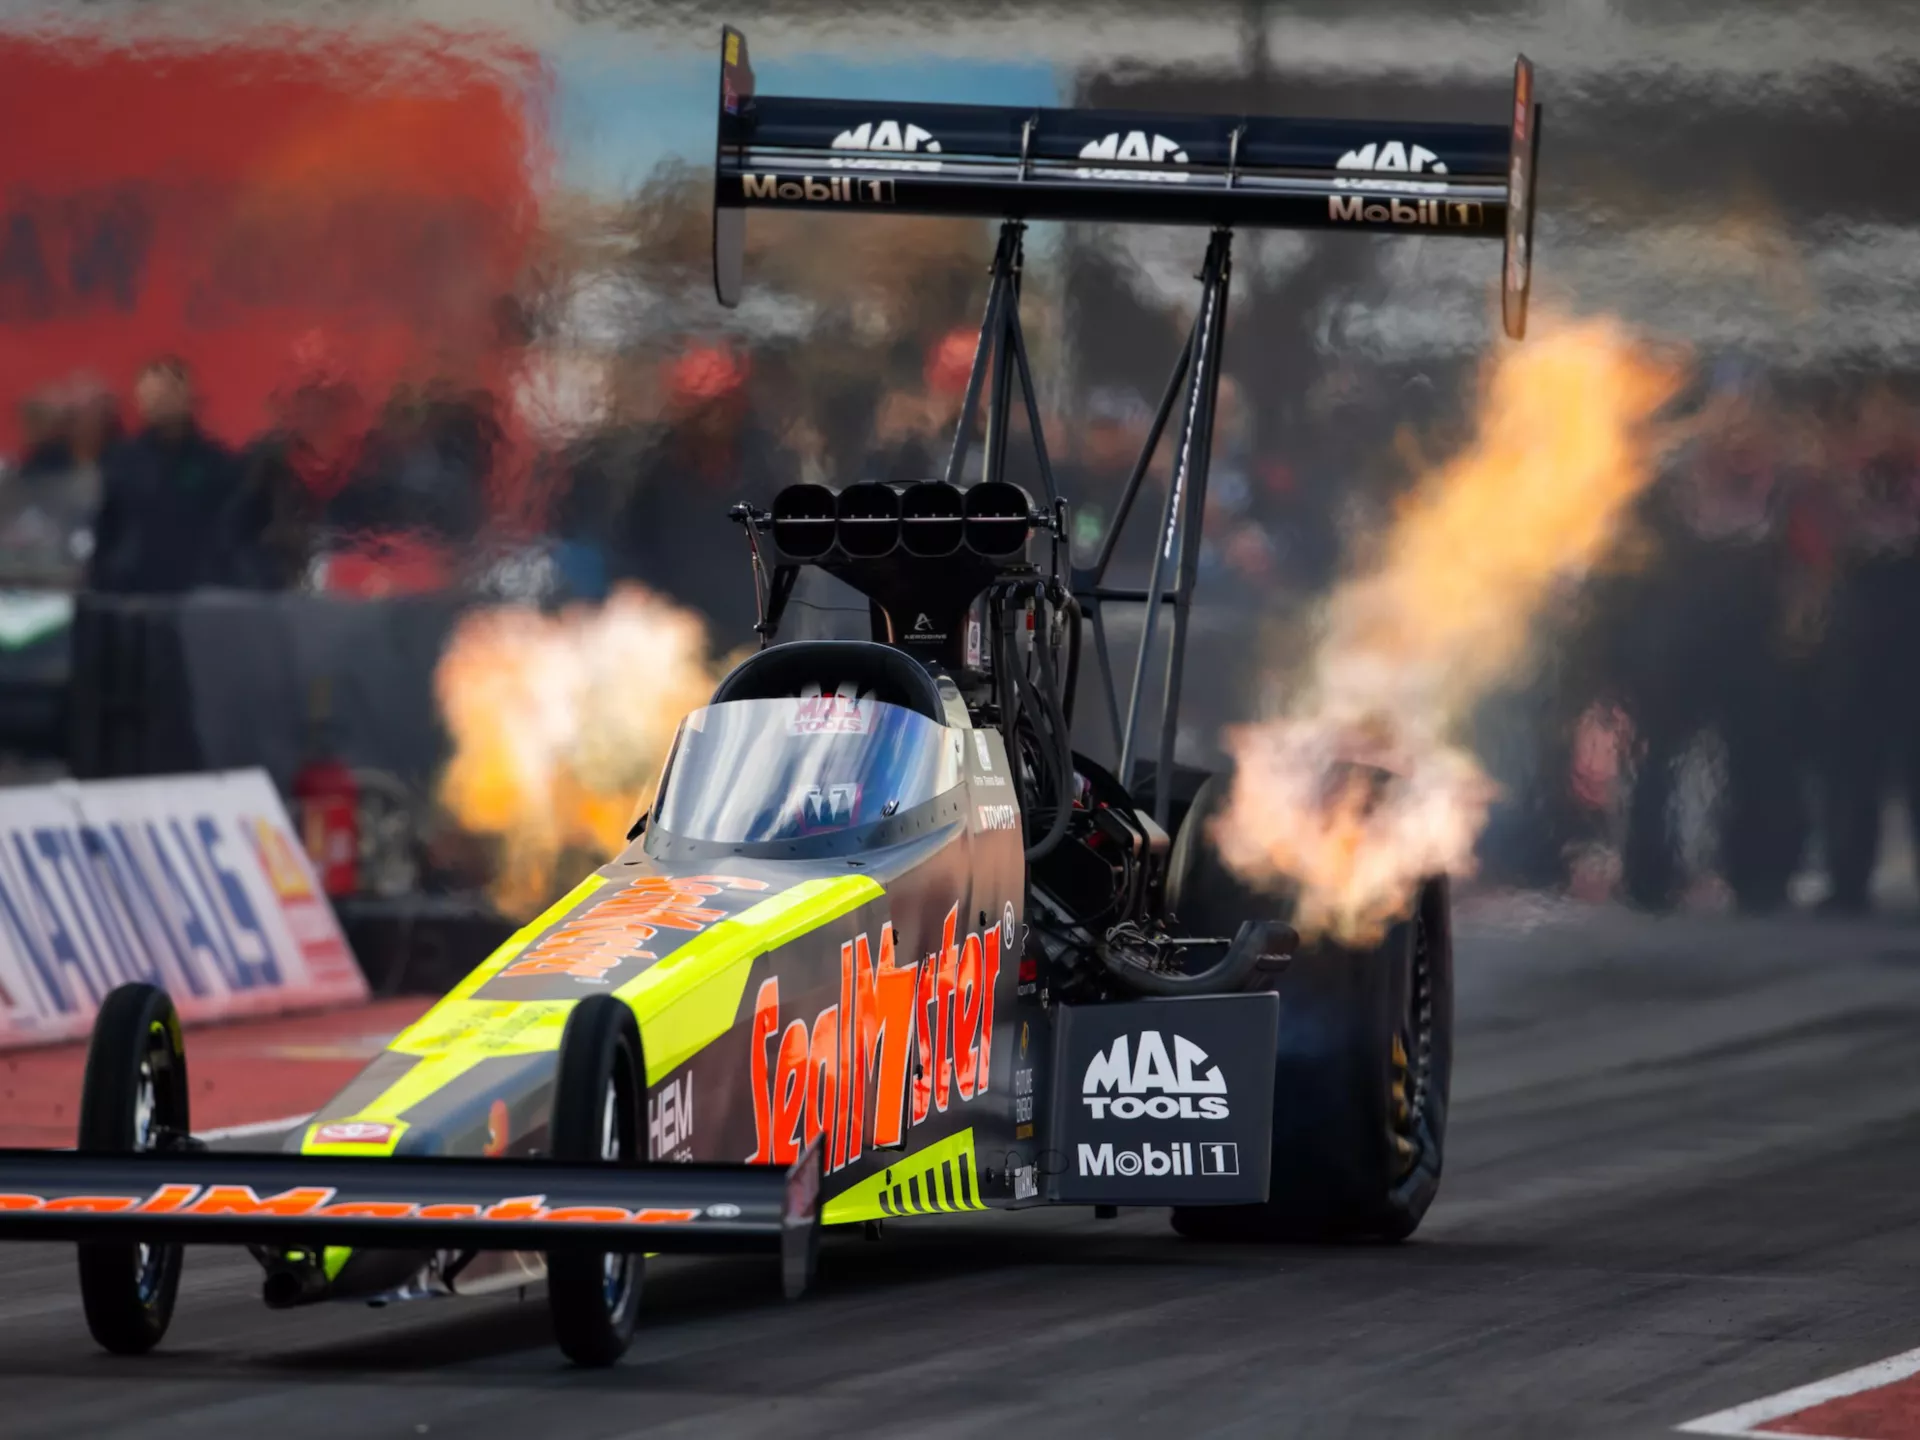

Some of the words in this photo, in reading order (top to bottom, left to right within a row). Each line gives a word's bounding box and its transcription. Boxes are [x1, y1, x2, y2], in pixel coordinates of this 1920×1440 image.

[742, 174, 850, 201] Mobil
[1329, 195, 1439, 225] Mobil
[984, 805, 1016, 830] TOYOTA
[1082, 1030, 1228, 1094] MAC
[1082, 1096, 1230, 1119] TOOLS
[1077, 1142, 1194, 1177] Mobil
